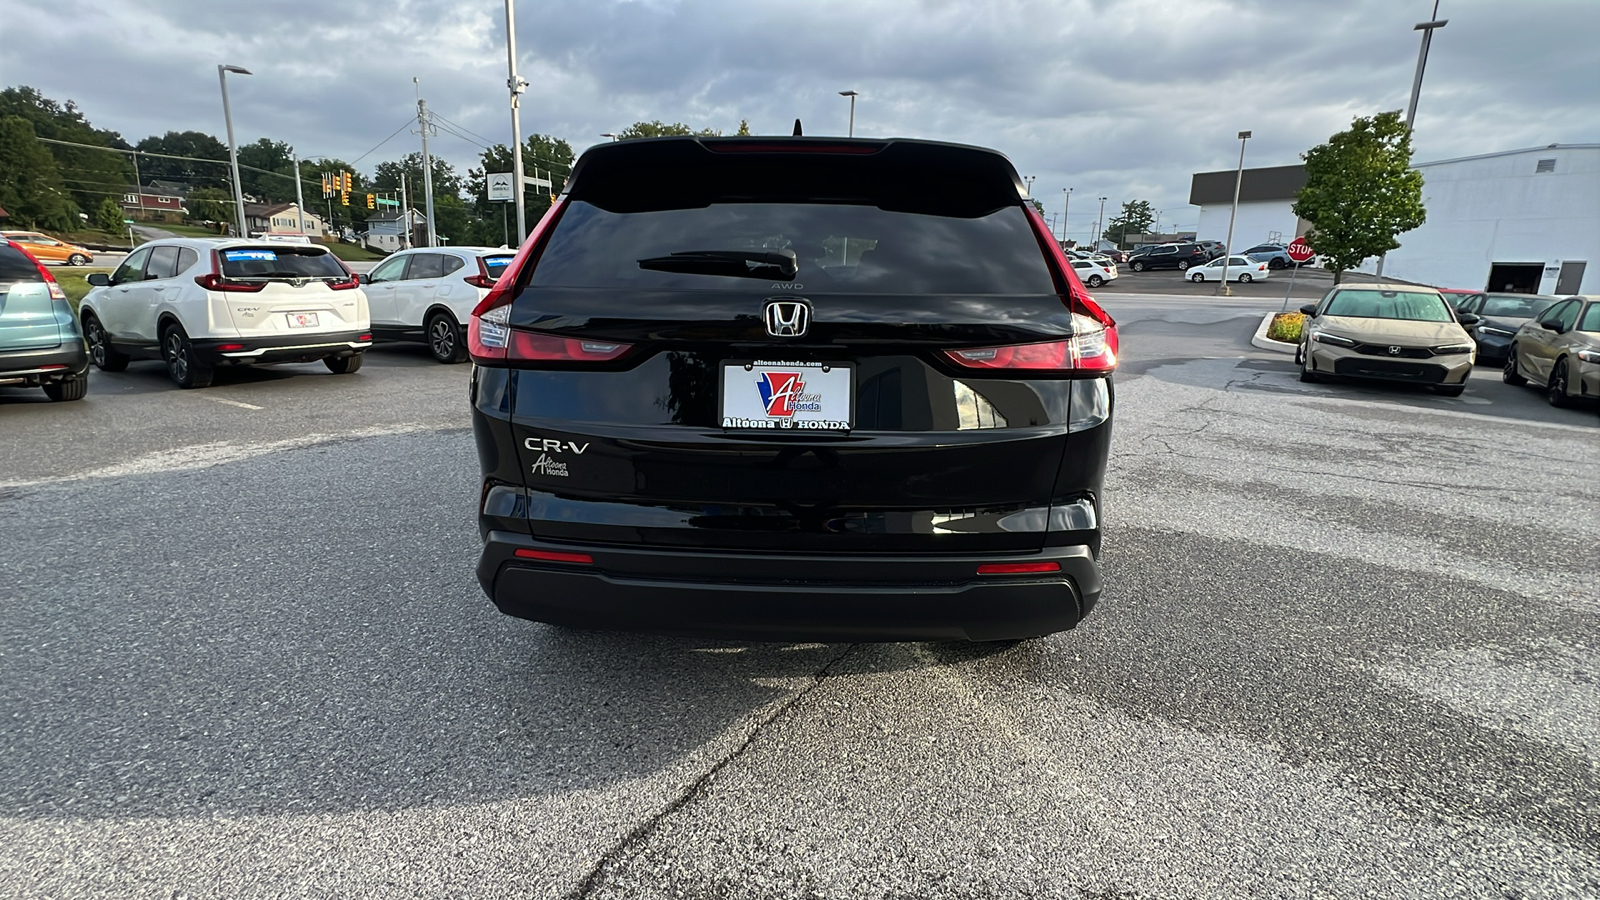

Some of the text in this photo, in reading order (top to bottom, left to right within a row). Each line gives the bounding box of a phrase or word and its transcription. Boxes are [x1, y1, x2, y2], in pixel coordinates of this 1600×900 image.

[768, 376, 820, 411] Altoona
[789, 401, 820, 411] Honda
[722, 418, 775, 428] Altoona
[797, 421, 850, 430] HONDA
[524, 437, 590, 454] CR-V
[531, 453, 567, 475] Altoona
[546, 468, 569, 477] Honda
